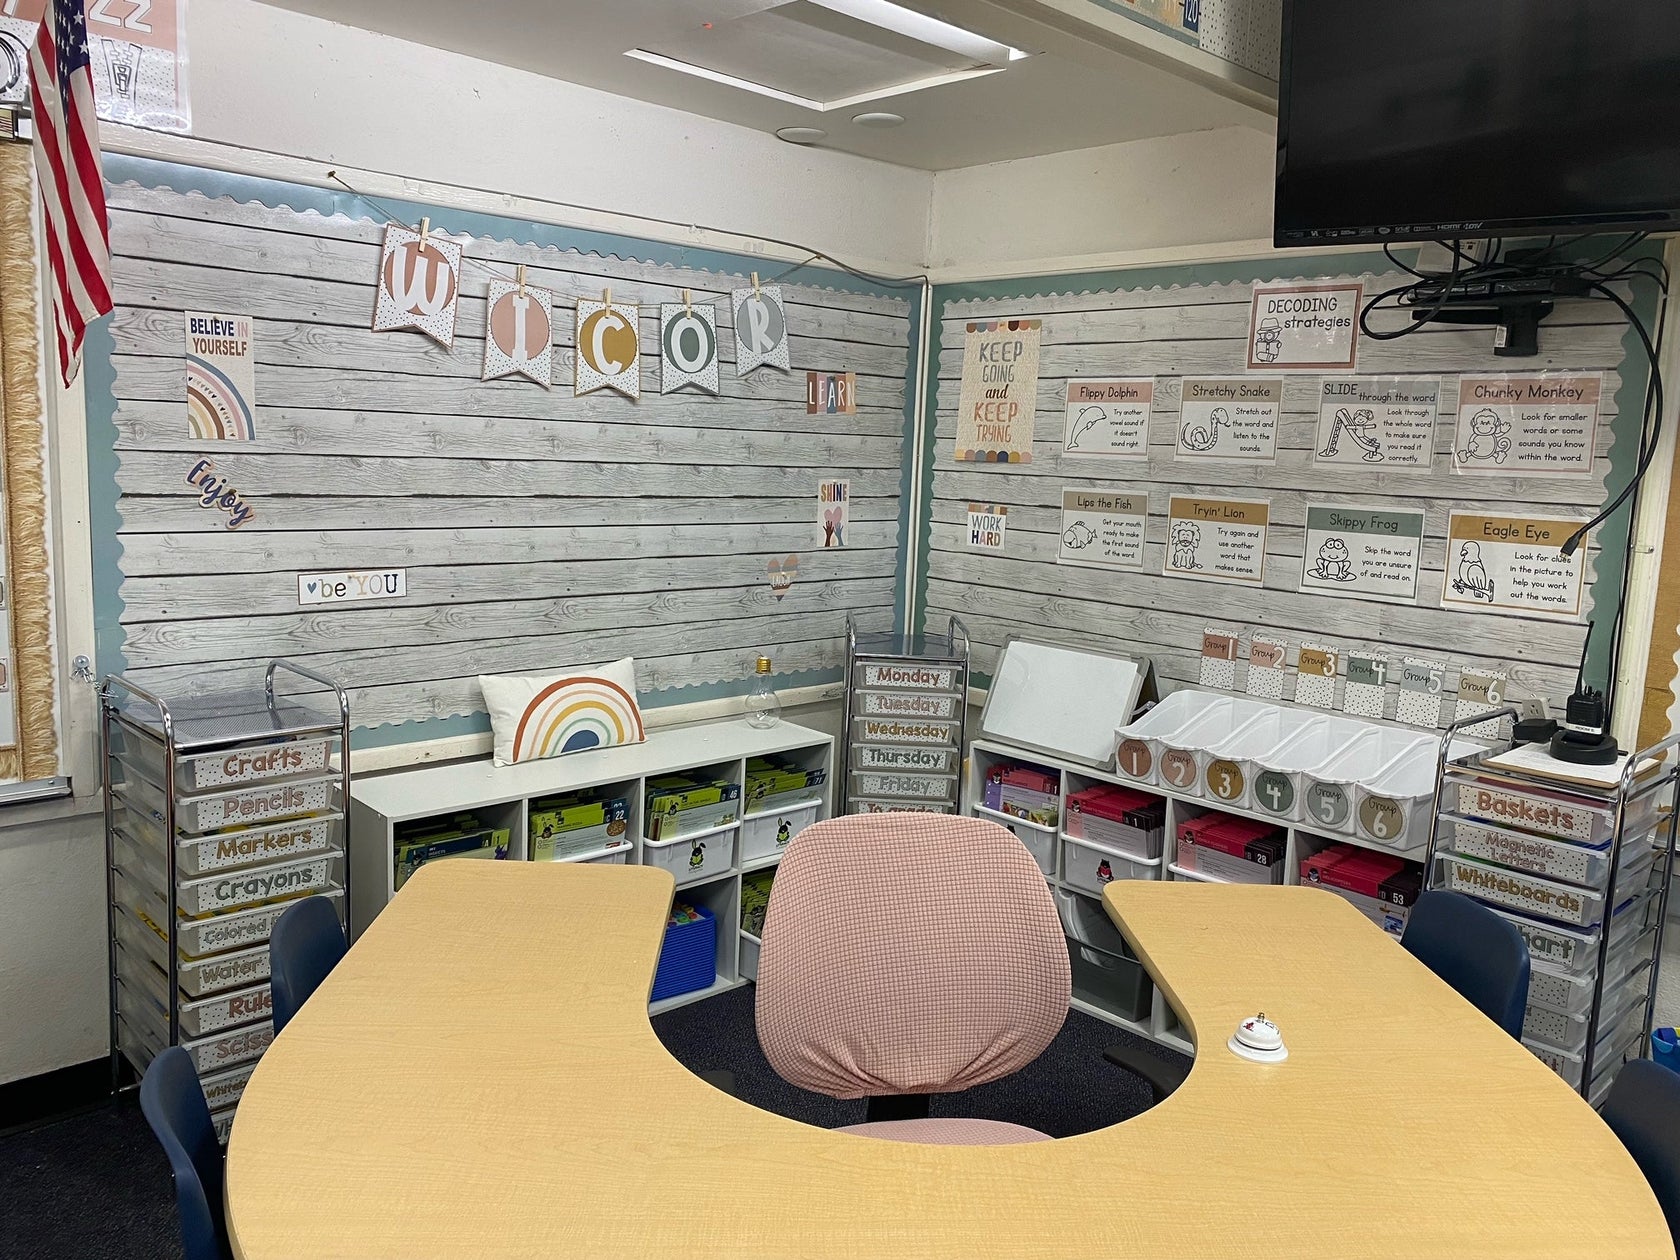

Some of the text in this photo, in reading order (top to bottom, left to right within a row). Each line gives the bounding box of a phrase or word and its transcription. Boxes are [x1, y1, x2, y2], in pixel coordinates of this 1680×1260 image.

[1268, 297, 1337, 314] DECODING
[190, 318, 248, 338] BELIEVE IN
[1284, 316, 1351, 330] strategies
[192, 338, 248, 357] YOURSELF
[979, 340, 1022, 362] KEEP
[982, 364, 1014, 382] GOING
[808, 380, 856, 408] LEARN
[986, 384, 1009, 399] and
[1080, 386, 1138, 400] Flippy Dolphin
[1193, 384, 1270, 399] Stretchy Snake
[1324, 383, 1436, 403] SLIDE through the word
[1475, 385, 1584, 400] Chunky Monkey
[974, 402, 1018, 422] KEEP
[1387, 408, 1430, 417] Look through
[976, 424, 1012, 442] TRYING
[1518, 440, 1545, 448] sounds
[1560, 454, 1583, 462] word.
[187, 459, 253, 526] Enjoy
[820, 482, 848, 502] SHINE
[1077, 496, 1132, 509] Lips the Fish
[1193, 504, 1245, 518] Tryin' Lion
[972, 515, 1001, 531] WORK
[1329, 513, 1398, 532] Skippy Frog
[1484, 522, 1550, 541] Eagle Eye
[972, 530, 1001, 546] HARD
[1217, 527, 1227, 536] Try
[1230, 530, 1245, 538] again
[1364, 546, 1378, 555] Skip
[1514, 552, 1571, 564] Look for clues
[1215, 564, 1234, 572] makes
[1534, 568, 1562, 578] picture
[320, 574, 398, 598] be YOU
[1513, 578, 1528, 587] help
[1548, 582, 1567, 590] work
[1526, 592, 1538, 600] the
[1204, 638, 1233, 660] Group 1
[1252, 646, 1285, 668] Group 2
[1301, 653, 1336, 676] Group 3
[1350, 662, 1386, 685] Group 4
[877, 668, 940, 686] Monday
[1404, 669, 1442, 694] Group 5
[1460, 678, 1500, 705] Group 6
[876, 696, 940, 713] Tuesday
[866, 721, 947, 739] Wednesday
[1123, 742, 1145, 754] Group
[223, 749, 302, 777] Crafts
[870, 750, 940, 767] Thursday
[1132, 752, 1137, 775] 1
[1167, 750, 1190, 767] Group
[1173, 762, 1185, 786] 2
[1215, 762, 1239, 777] Group
[879, 777, 930, 794] Friday
[1219, 774, 1231, 798] 3
[1262, 771, 1287, 791] Group
[1266, 784, 1280, 810] 4
[1315, 783, 1342, 802] Group
[223, 787, 304, 819] Pencils
[1321, 797, 1334, 823] 5
[1368, 796, 1396, 818] Group
[1477, 790, 1574, 831] Baskets
[615, 810, 625, 820] 22
[1373, 811, 1387, 837] 6
[216, 829, 312, 859] Markers
[1485, 832, 1554, 859] Magnetic
[1257, 853, 1267, 865] 28
[1490, 847, 1546, 872] Letters
[215, 867, 313, 900] Crayons
[1456, 866, 1579, 913] Whiteboards
[1393, 892, 1404, 905] 53
[205, 919, 266, 944] Colored
[1520, 924, 1573, 958] hart
[202, 959, 260, 984] Water
[216, 1032, 274, 1059] Sciss
